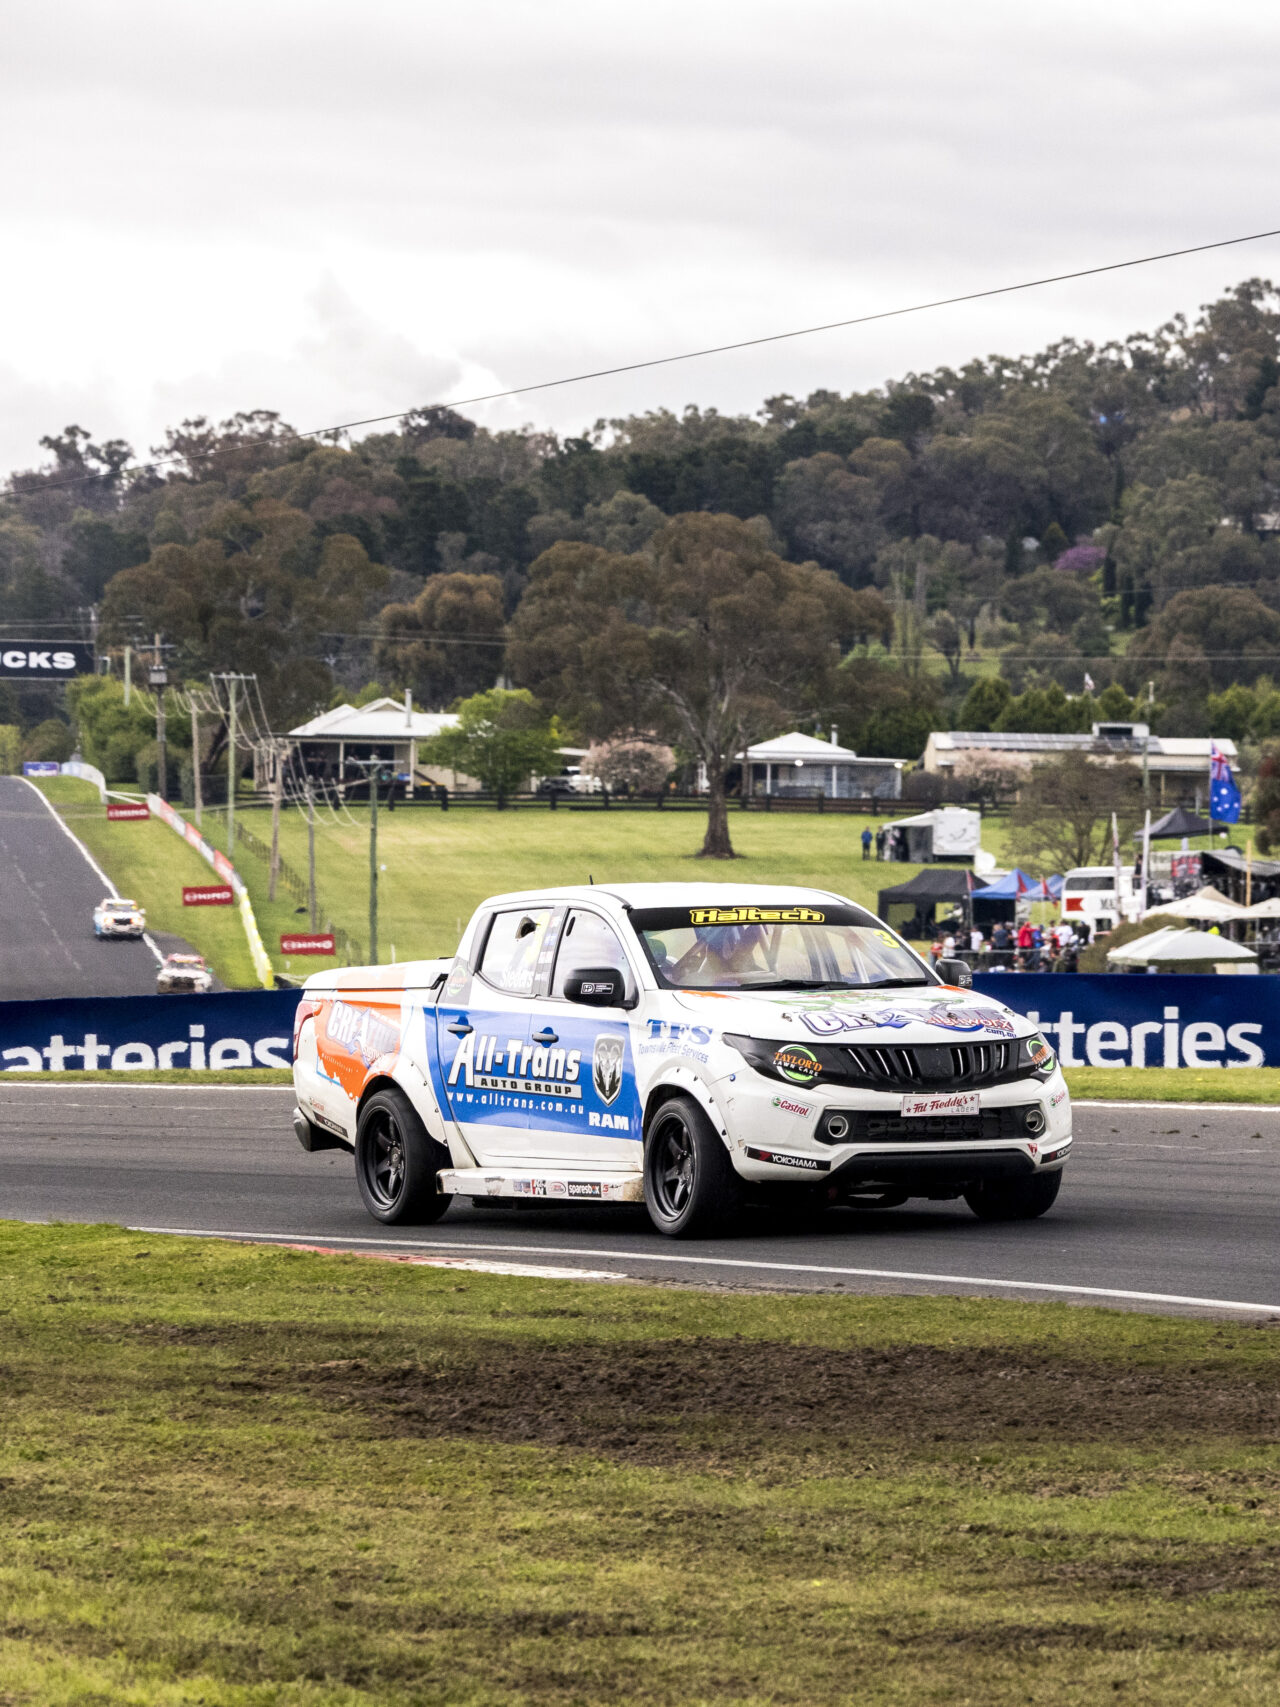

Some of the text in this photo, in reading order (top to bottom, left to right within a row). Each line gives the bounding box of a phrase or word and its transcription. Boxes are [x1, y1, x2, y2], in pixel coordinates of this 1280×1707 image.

[0, 650, 77, 670] CKS
[691, 907, 825, 924] Haltech
[872, 929, 901, 949] 3
[1, 1024, 291, 1071] atteries
[448, 1031, 582, 1087] All-Trans
[772, 1060, 819, 1077] LAWN CARE
[773, 1051, 823, 1073] TAYLOR'D
[480, 1078, 573, 1095] AUTO GROUP
[448, 1091, 585, 1115] www.alltrans.com.au
[780, 1099, 809, 1116] Castrol
[912, 1096, 968, 1114] Fat Freddy's
[588, 1111, 630, 1131] RAM
[772, 1153, 818, 1169] YOKOHAMA
[568, 1183, 601, 1195] sparesbox
